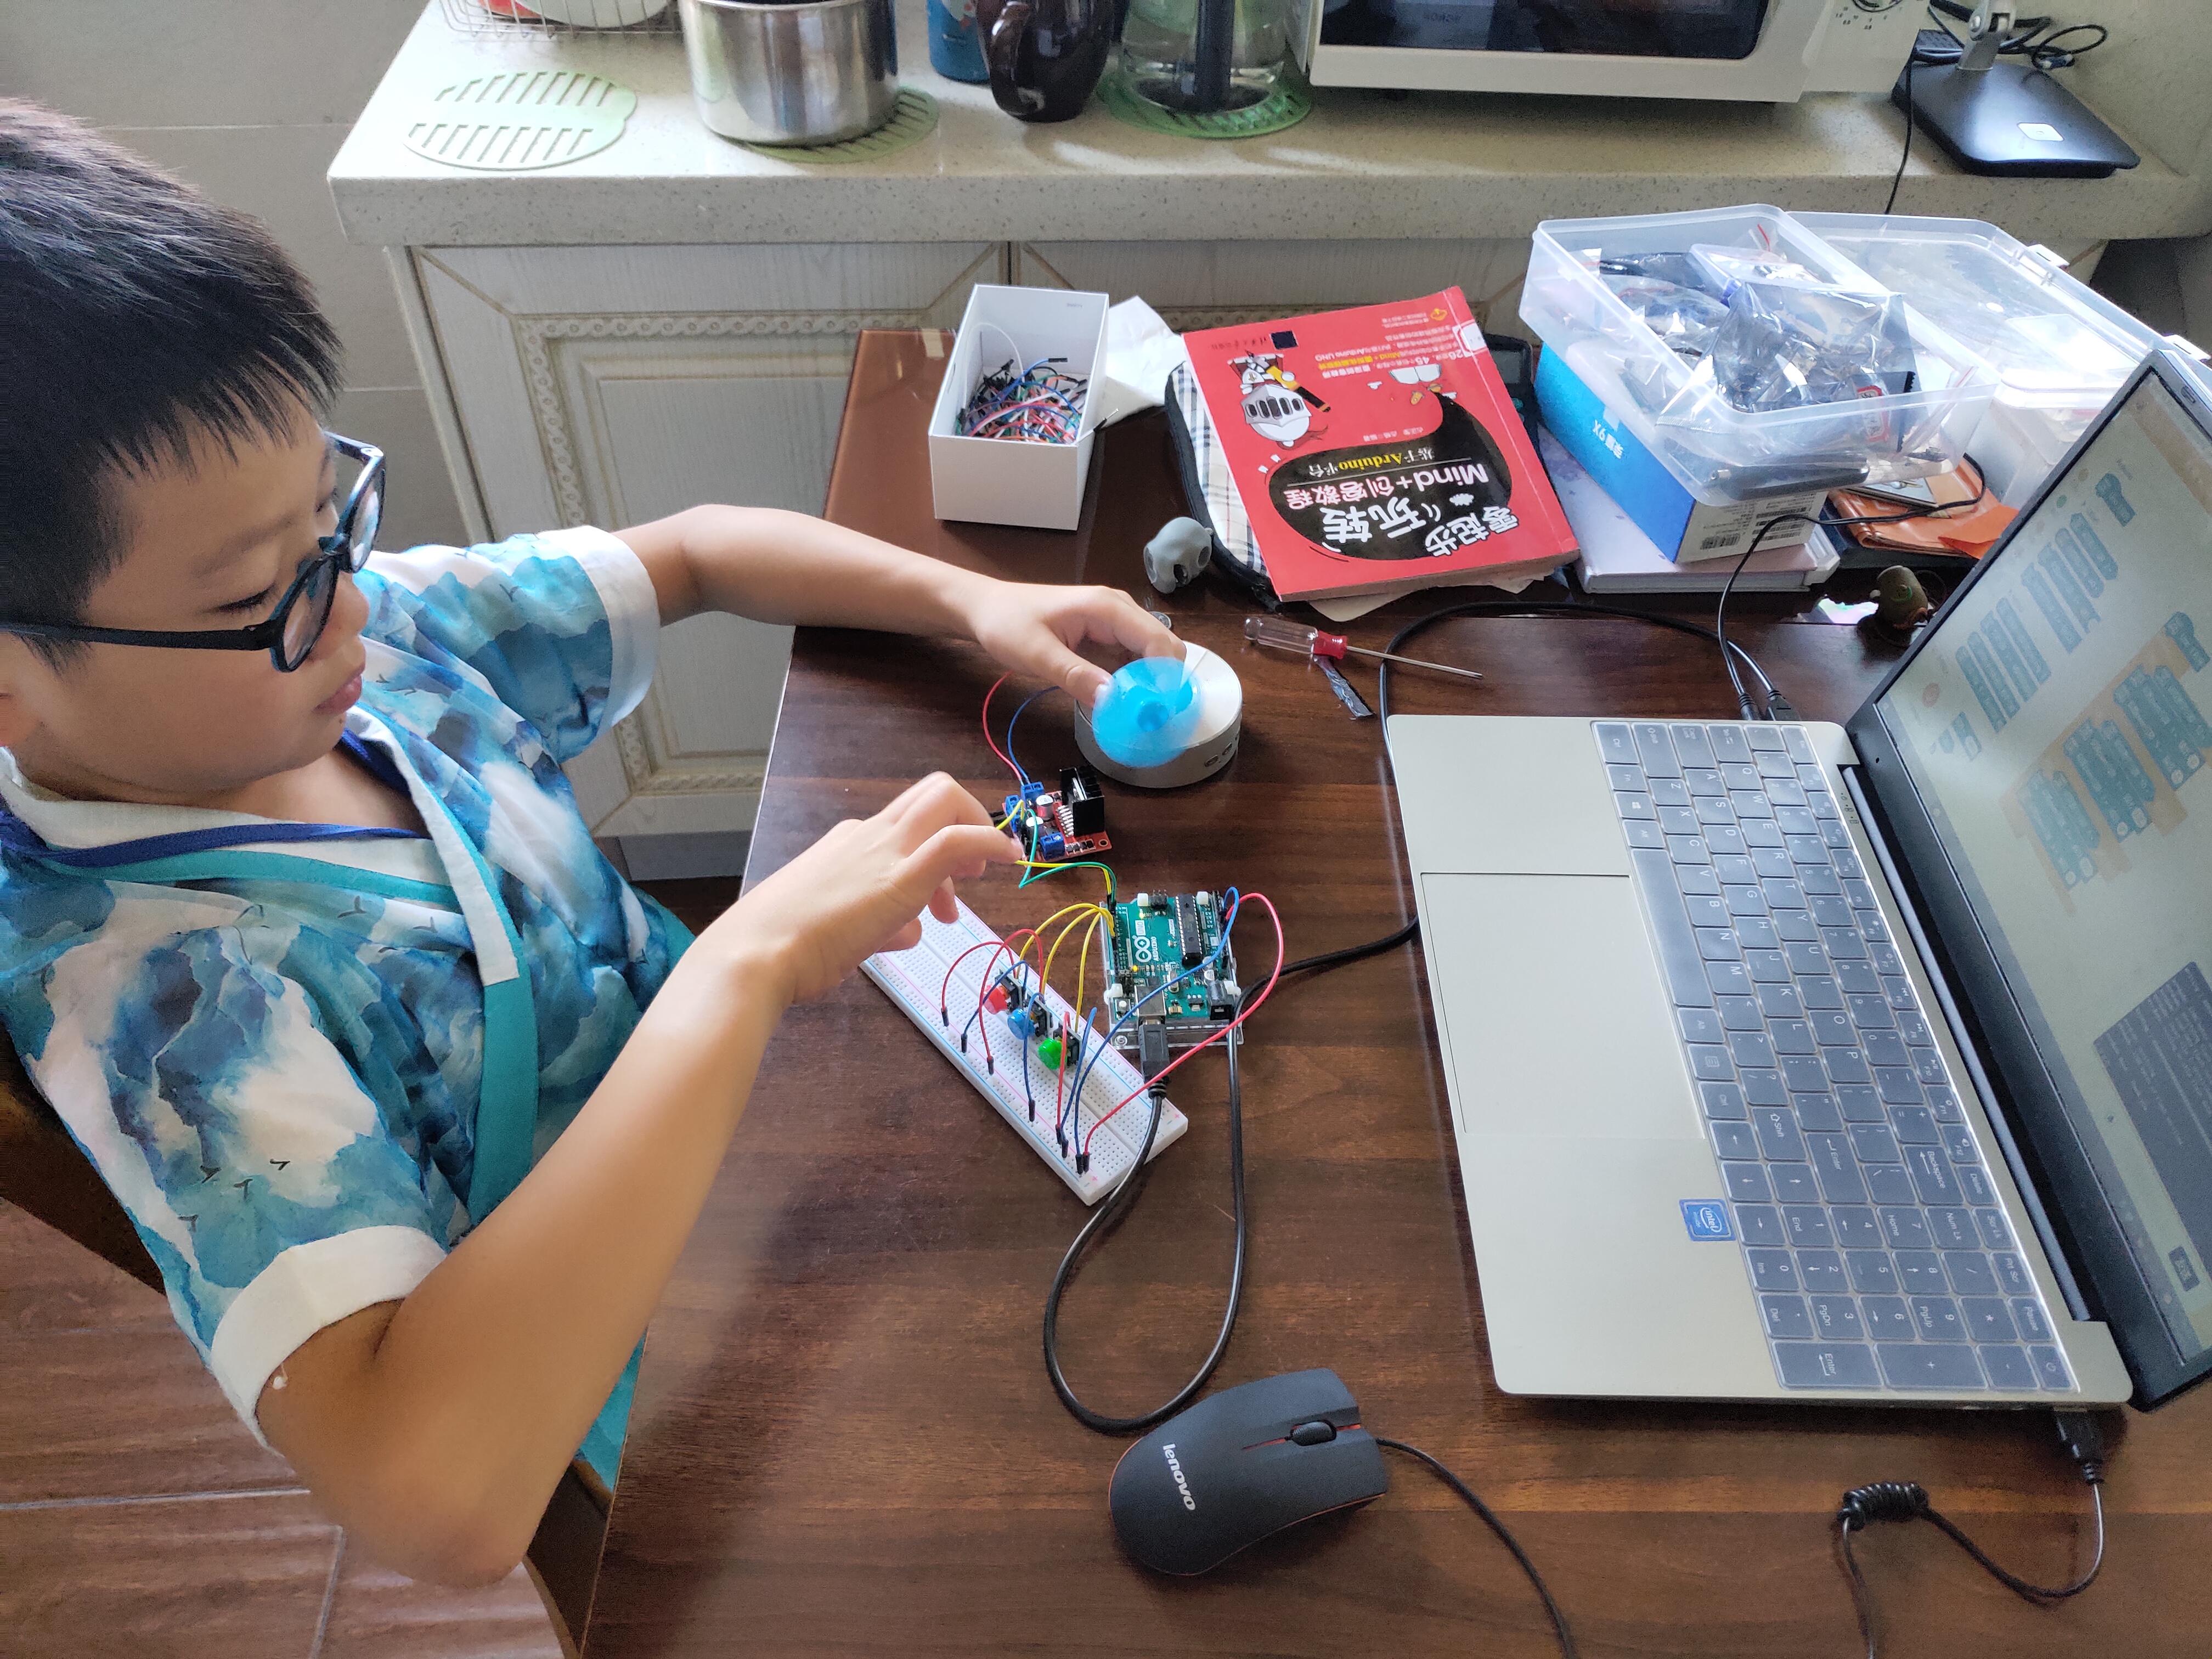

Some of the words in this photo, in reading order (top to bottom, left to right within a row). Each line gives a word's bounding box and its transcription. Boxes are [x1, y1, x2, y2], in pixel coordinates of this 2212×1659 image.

[1319, 496, 1426, 544] 玩转
[1425, 505, 1519, 557] 零起步
[1753, 795, 1764, 803] W
[1151, 936, 1159, 962] ARDUINO
[1730, 966, 1742, 974] M
[1833, 1015, 1845, 1024] O
[1774, 1122, 1784, 1137] Shift
[1830, 1152, 1841, 1170] Enter
[1927, 1151, 1945, 1188] Backspace
[1970, 1173, 1982, 1194] Delete
[1705, 1210, 1719, 1229] intel
[1792, 1217, 1802, 1231] End
[1888, 1215, 1899, 1235] Home
[1946, 1212, 1956, 1229] Num
[1953, 1231, 1961, 1240] Lk
[1987, 1215, 1996, 1227] Scr
[1993, 1229, 2001, 1238] Lk
[2010, 1271, 2019, 1282] Scr
[1770, 1308, 1780, 1321] Del
[1819, 1305, 1830, 1325] PgDn
[1920, 1306, 1932, 1327] PgUp
[2024, 1306, 2038, 1330] Pause
[1825, 1353, 1836, 1374] Enter
[1163, 1443, 1195, 1510] lenovo
